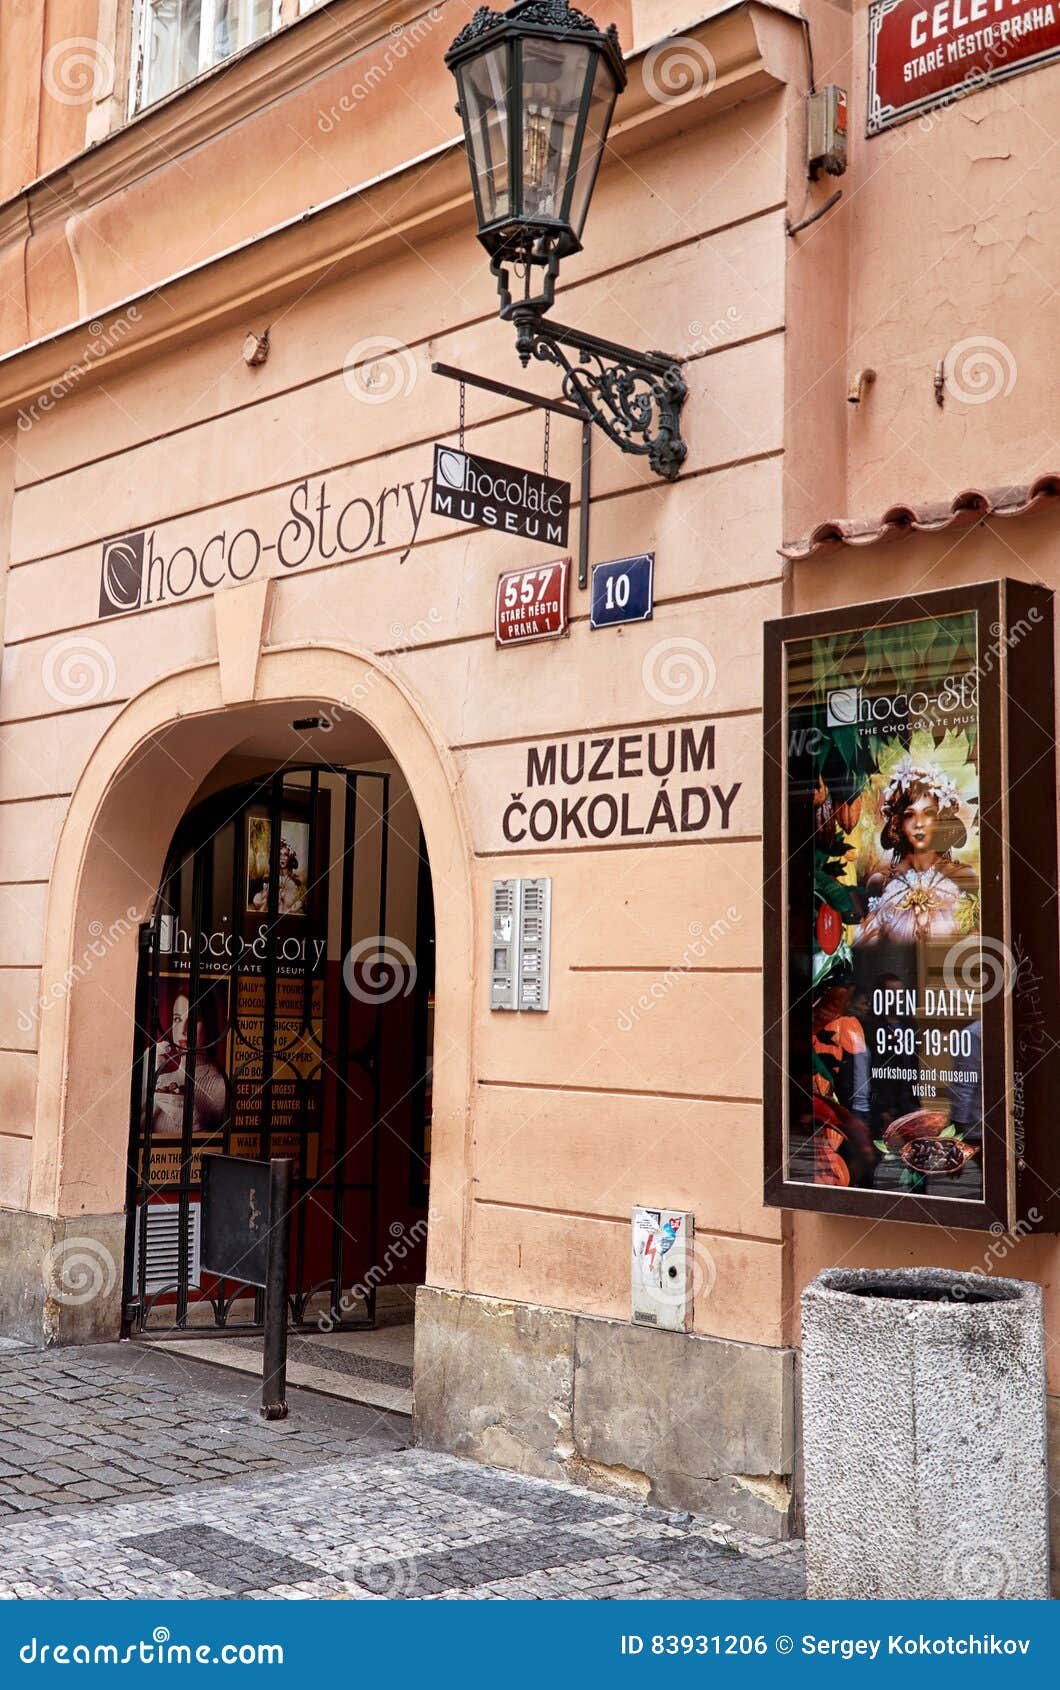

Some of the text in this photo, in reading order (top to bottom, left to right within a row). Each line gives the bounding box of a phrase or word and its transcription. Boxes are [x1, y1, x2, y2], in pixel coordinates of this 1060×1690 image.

[911, 0, 1026, 48] CELE
[903, 44, 945, 82] STARÉ
[437, 448, 563, 516] Chocolate
[435, 492, 563, 543] MUSEUM
[98, 477, 433, 618] Choco-Story
[504, 568, 553, 607] 557
[605, 574, 630, 609] 10
[500, 600, 559, 623] STARÉ MĚSTO
[508, 618, 551, 638] PRAHA 1
[858, 715, 978, 736] THE CHOCOLATE MUS
[526, 725, 716, 787] MUZEUM
[502, 778, 743, 843] ČOKOLÁDY
[149, 914, 326, 972] hoco-Soy
[238, 982, 258, 994] DAILY
[873, 988, 975, 1017] OPEN DAILY
[238, 998, 321, 1011] CHOCOL WORKSPS
[876, 1027, 972, 1057] 9:30-19:00
[872, 1066, 978, 1083] workshops and museum
[236, 1084, 296, 1095] SEE TH RGEST
[911, 1084, 937, 1098] visits
[236, 1099, 315, 1111] CHOCOE WATERLL
[235, 1115, 244, 1127] IN
[245, 1115, 259, 1127] THE
[141, 1169, 182, 1181] OCOLAT
